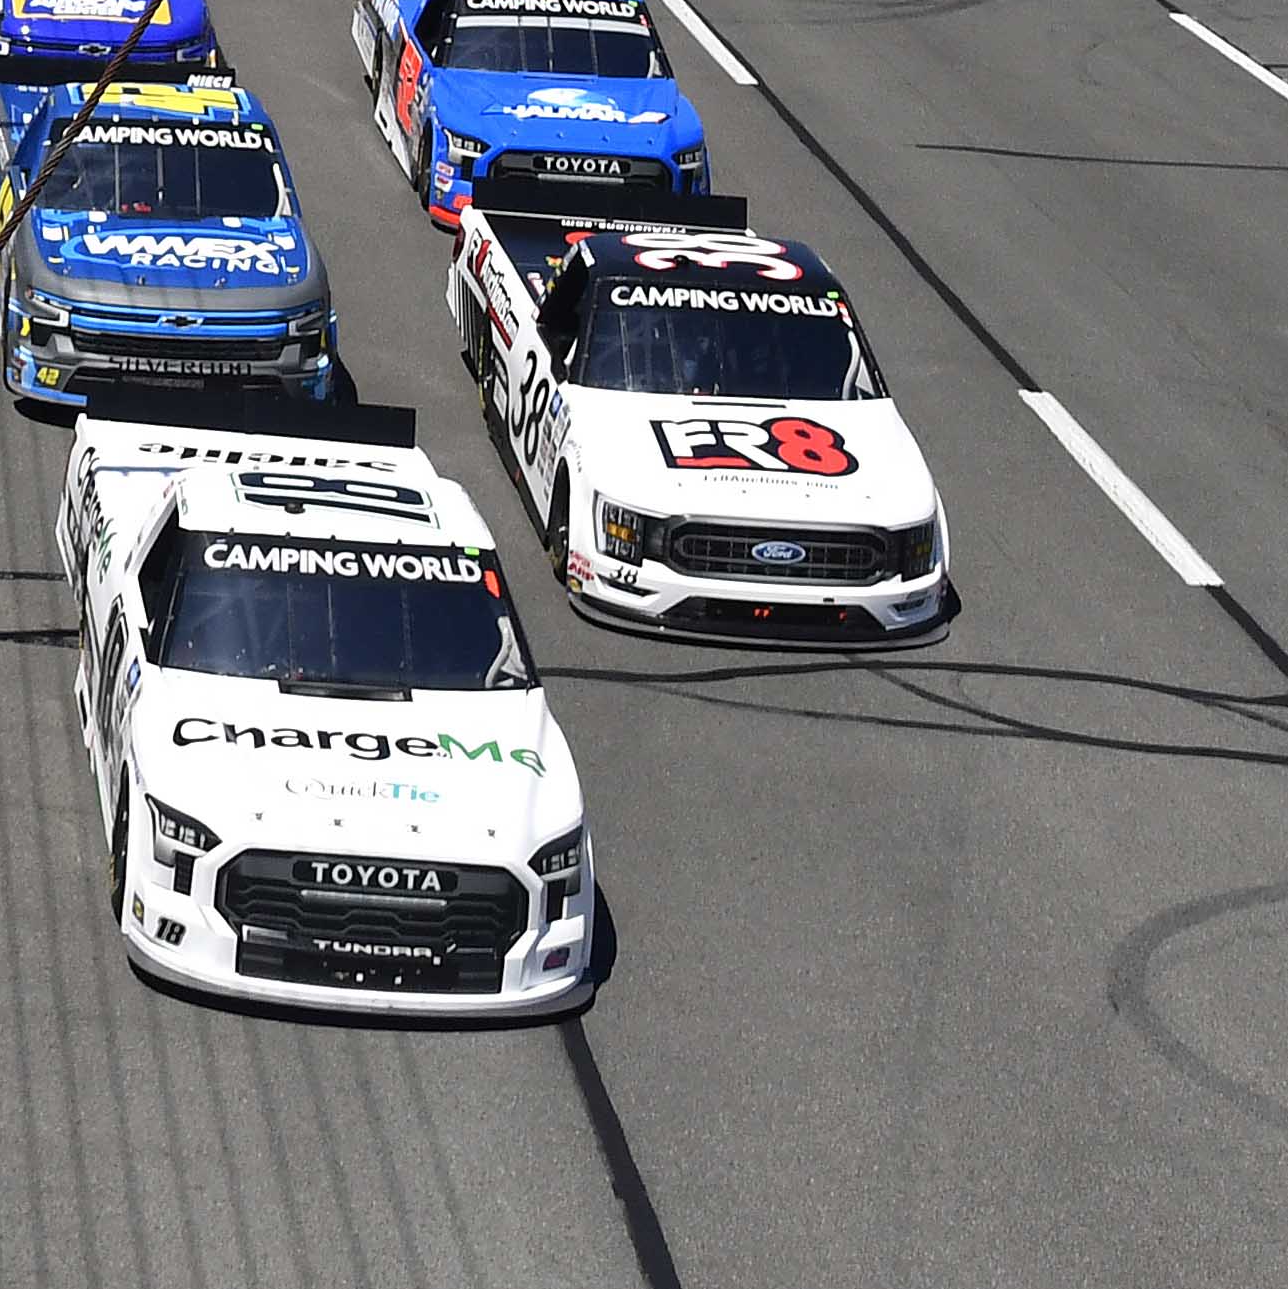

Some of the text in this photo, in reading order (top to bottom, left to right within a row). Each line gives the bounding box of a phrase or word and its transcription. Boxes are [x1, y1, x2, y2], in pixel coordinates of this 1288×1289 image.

[186, 74, 232, 89] NIECE
[503, 102, 627, 123] HALMAR
[173, 128, 262, 150] WORLD
[544, 157, 622, 175] TOYOTA
[130, 253, 281, 274] RACING
[622, 231, 805, 283] 38
[610, 286, 839, 318] CAMPING WORLD
[36, 367, 59, 385] 42
[511, 350, 550, 467] 38
[651, 407, 860, 476] FR8
[203, 542, 482, 583] CAMPING WORLD
[609, 565, 639, 585] 38
[310, 861, 442, 892] TOYOTA
[155, 917, 187, 947] 18
[312, 939, 435, 959] TUNDRA
